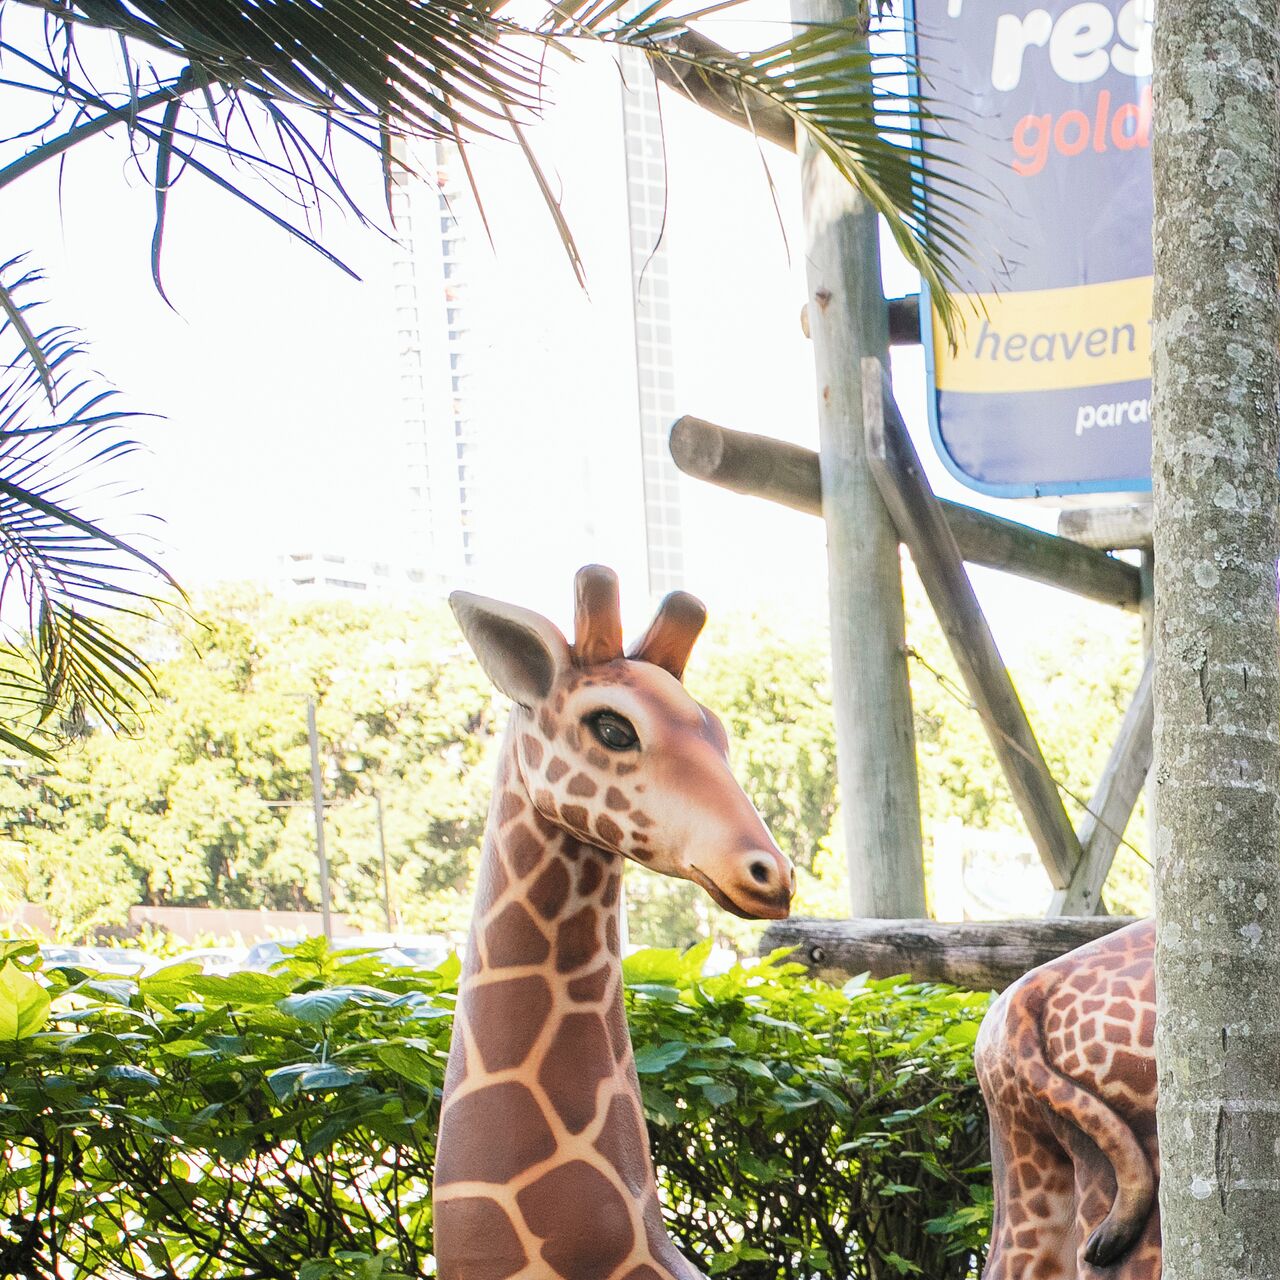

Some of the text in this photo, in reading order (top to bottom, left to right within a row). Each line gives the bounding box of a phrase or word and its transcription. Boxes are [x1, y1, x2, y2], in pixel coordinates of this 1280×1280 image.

[1011, 86, 1154, 176] gold
[974, 319, 1137, 363] heaven
[1075, 399, 1152, 437] para
